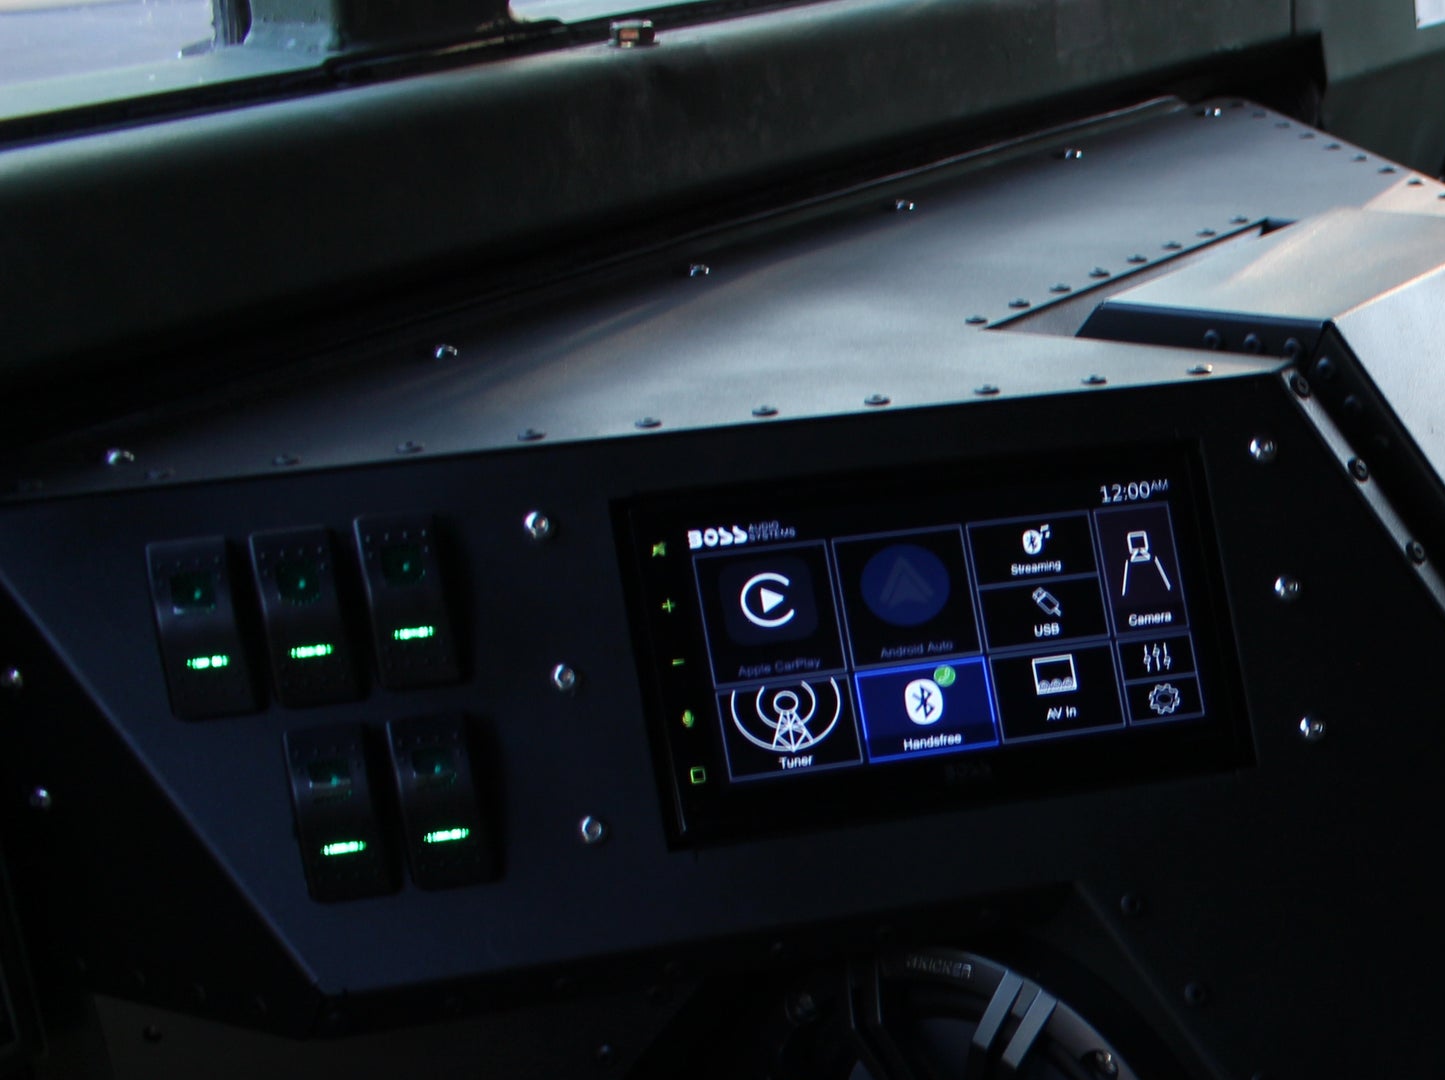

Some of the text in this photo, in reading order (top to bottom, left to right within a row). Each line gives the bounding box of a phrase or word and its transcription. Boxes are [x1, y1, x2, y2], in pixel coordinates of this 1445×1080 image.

[688, 525, 748, 549] BOSS
[1010, 560, 1062, 576] Streaming
[1128, 611, 1172, 627] Camera
[1034, 622, 1060, 637] USB
[880, 640, 954, 659] Android Auto
[738, 656, 822, 678] Apple CarPlay
[1046, 705, 1077, 721] AV In
[903, 733, 962, 751] Handsfree
[779, 753, 813, 770] Tuner
